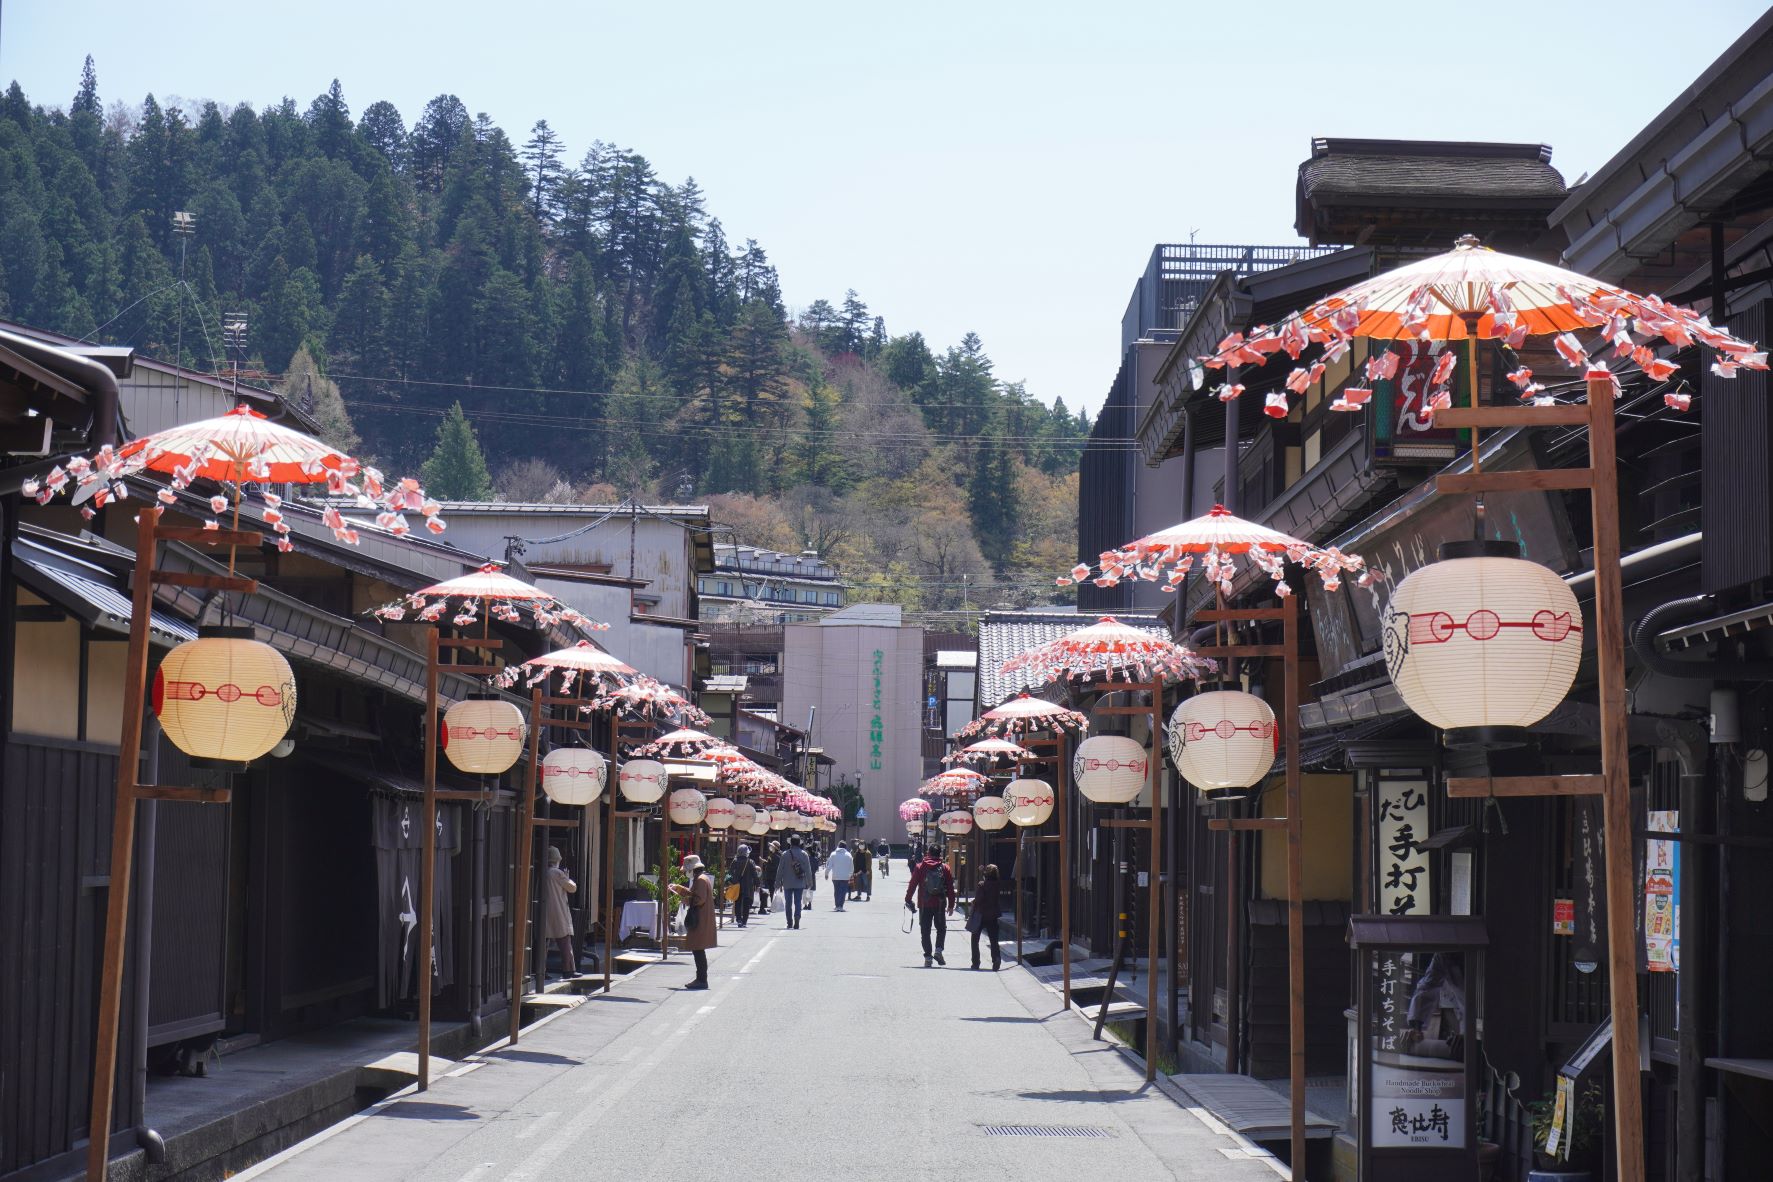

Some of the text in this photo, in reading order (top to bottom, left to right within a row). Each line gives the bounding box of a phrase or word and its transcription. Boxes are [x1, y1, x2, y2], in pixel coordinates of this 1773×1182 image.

[1380, 959, 1398, 1051] 手打ちそば
[1385, 1079, 1420, 1087] Handmade
[1401, 1087, 1441, 1096] Noodle Shop
